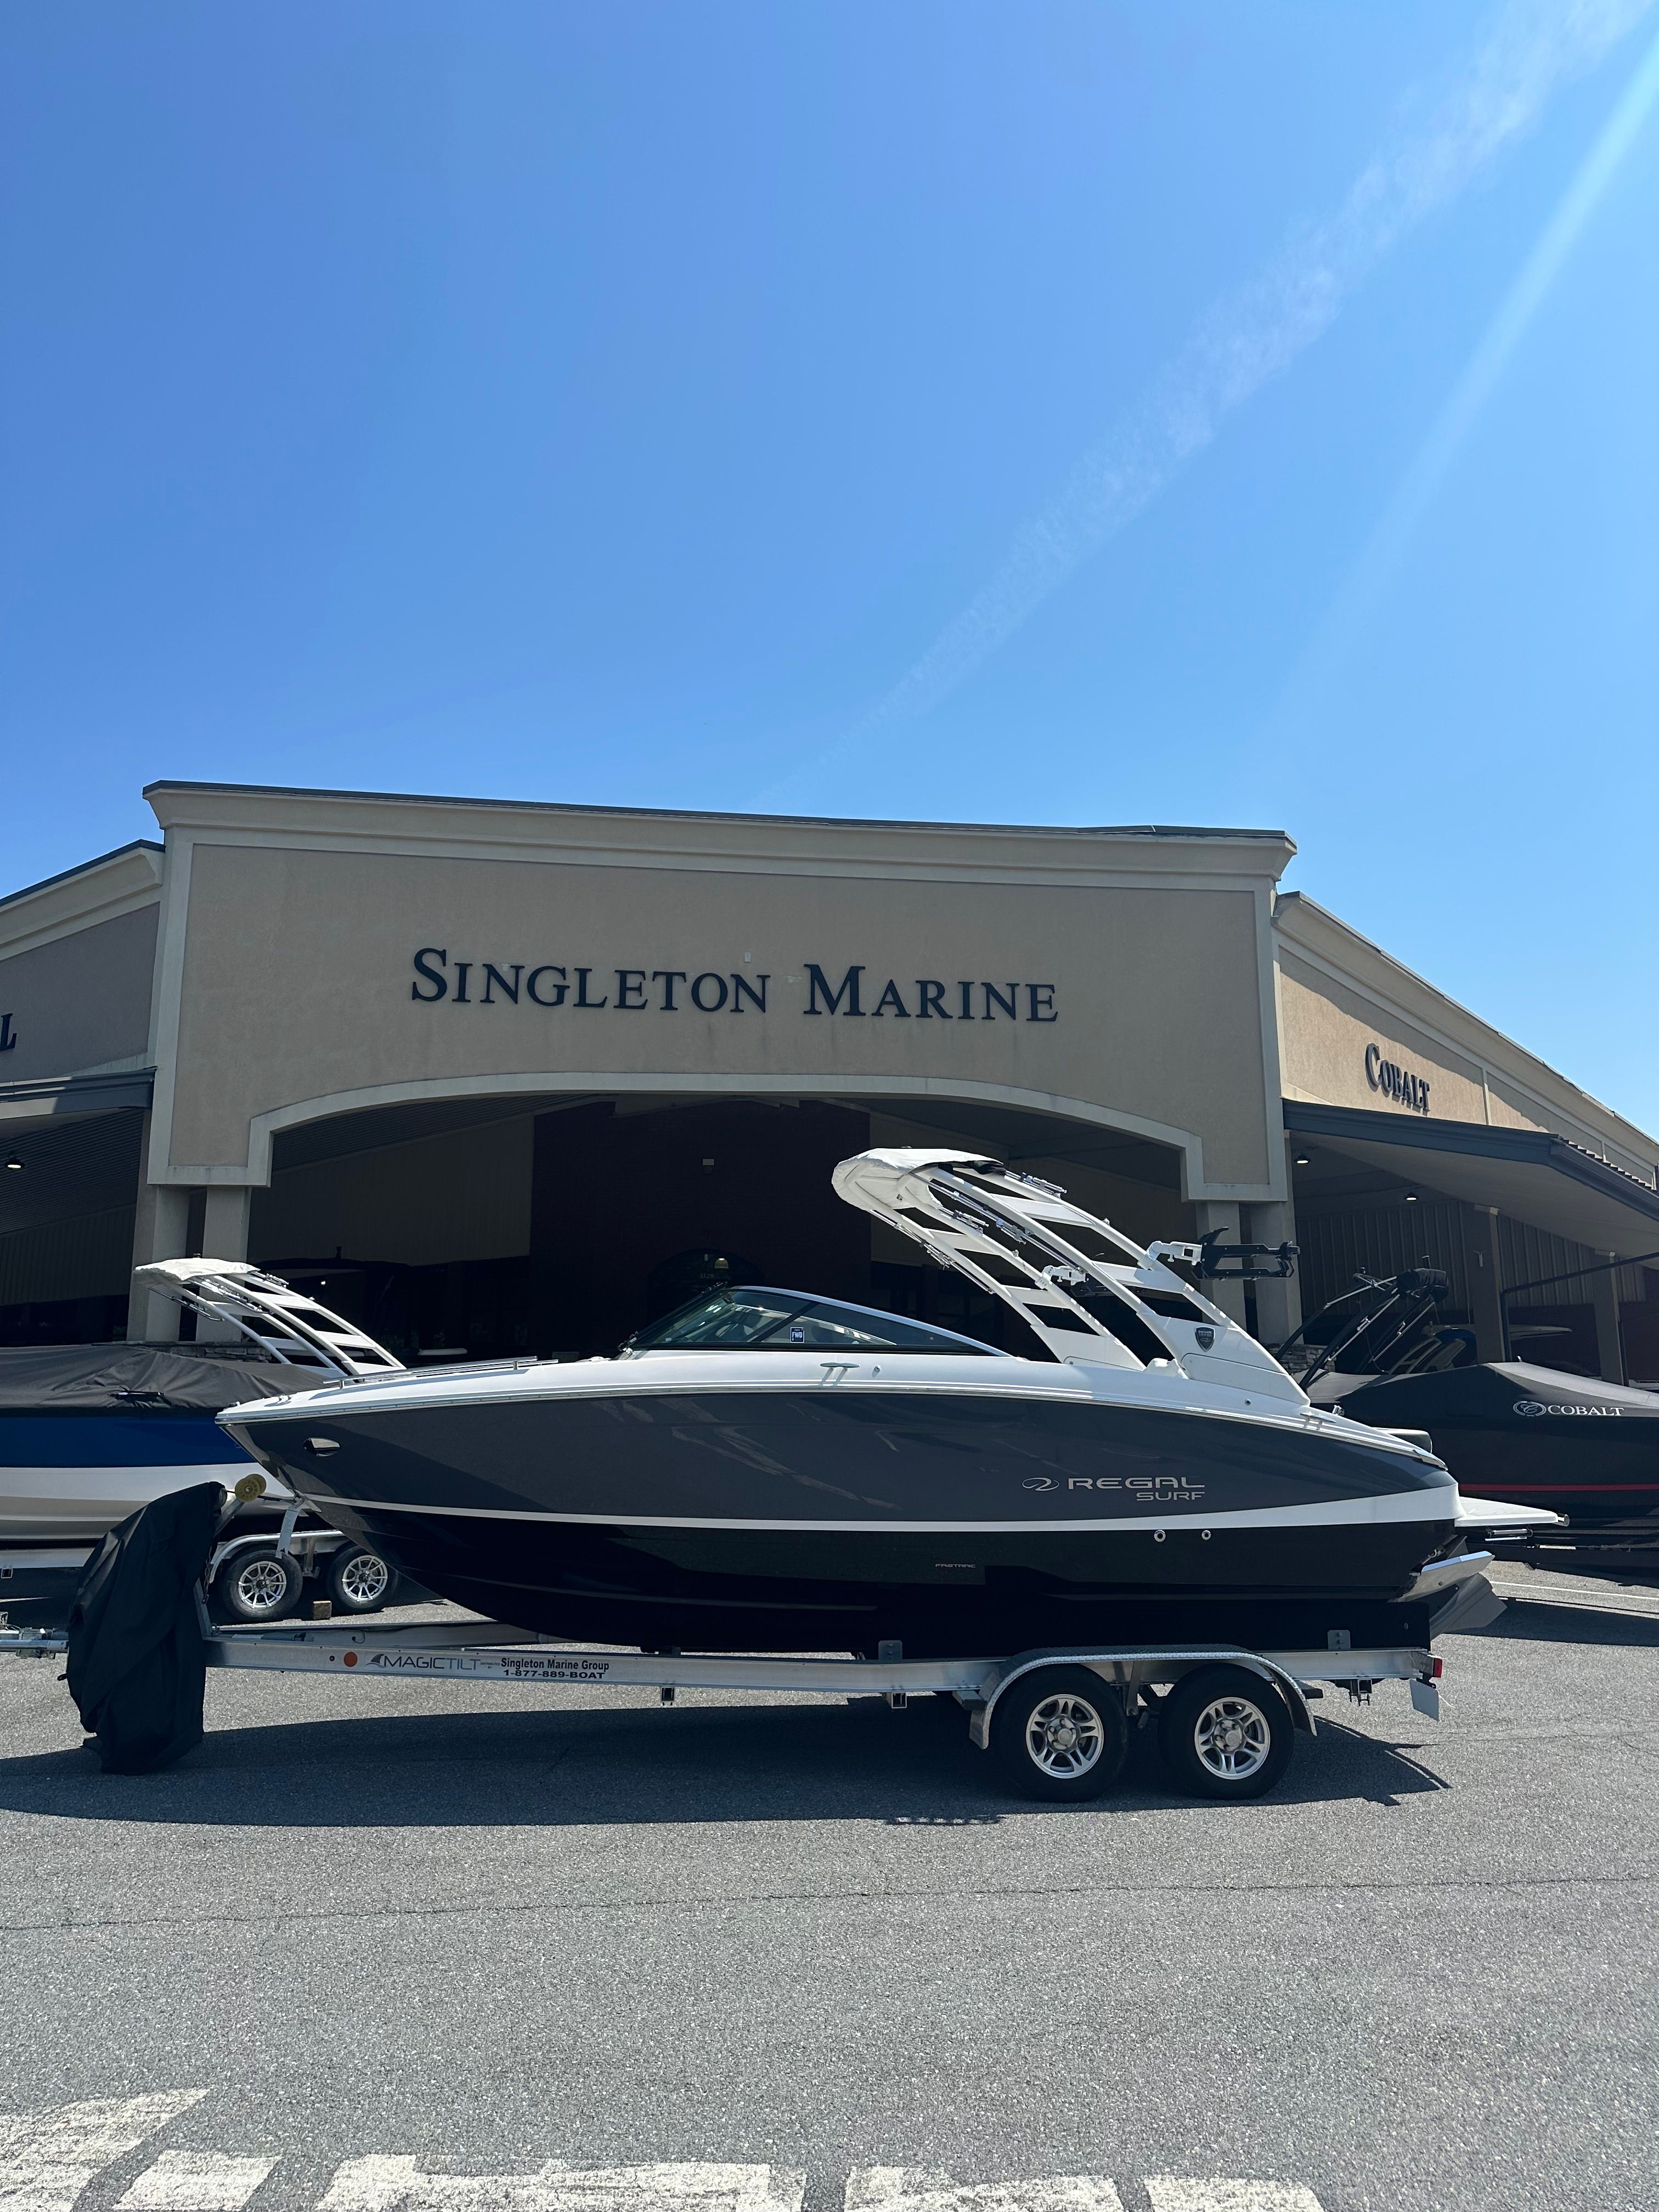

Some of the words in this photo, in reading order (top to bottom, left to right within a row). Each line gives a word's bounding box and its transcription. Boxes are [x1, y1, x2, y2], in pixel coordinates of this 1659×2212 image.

[411, 947, 770, 1014] SINGLETON
[803, 963, 1059, 1022] MARINE
[1365, 1042, 1430, 1111] COBALT
[1548, 1405, 1624, 1416] COBALT
[1068, 1476, 1205, 1489] REGAL
[1136, 1492, 1205, 1501] SURF
[384, 1655, 481, 1671] MAGICTILT
[501, 1657, 544, 1670] Singleton
[548, 1659, 578, 1669] Marine
[582, 1660, 609, 1672] Group
[504, 1669, 605, 1679] 1-877-889-BOAT
